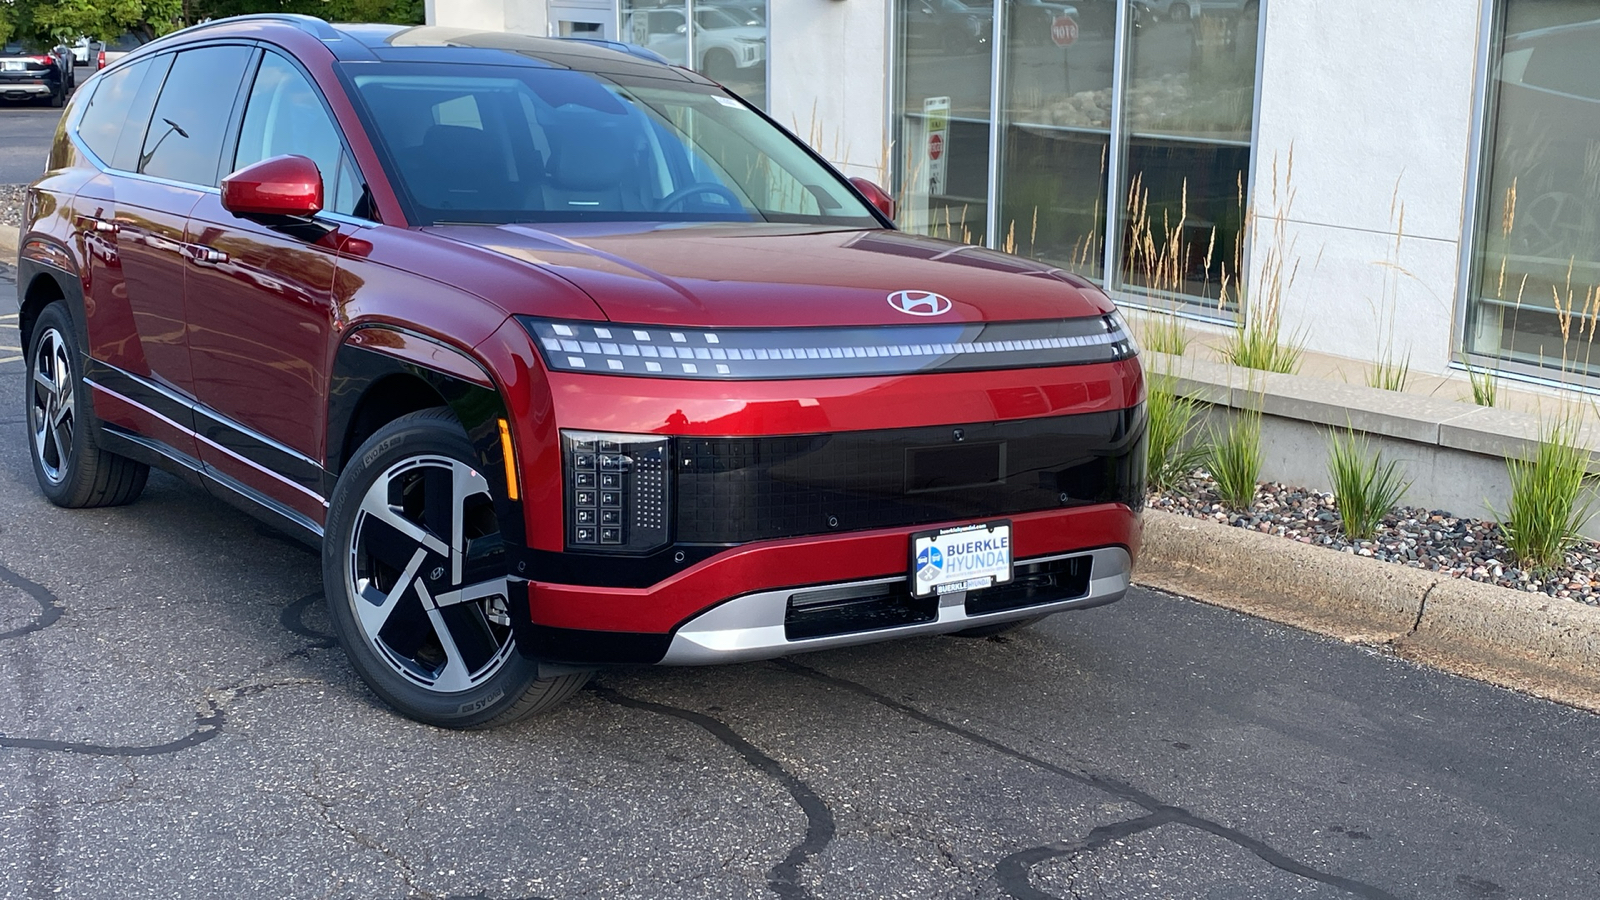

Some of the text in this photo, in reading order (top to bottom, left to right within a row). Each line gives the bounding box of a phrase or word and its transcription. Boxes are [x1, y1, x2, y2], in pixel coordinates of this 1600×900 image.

[947, 537, 1008, 557] BUERKLE
[946, 549, 1009, 574] HYUNDAI
[937, 581, 968, 594] BUERKLE
